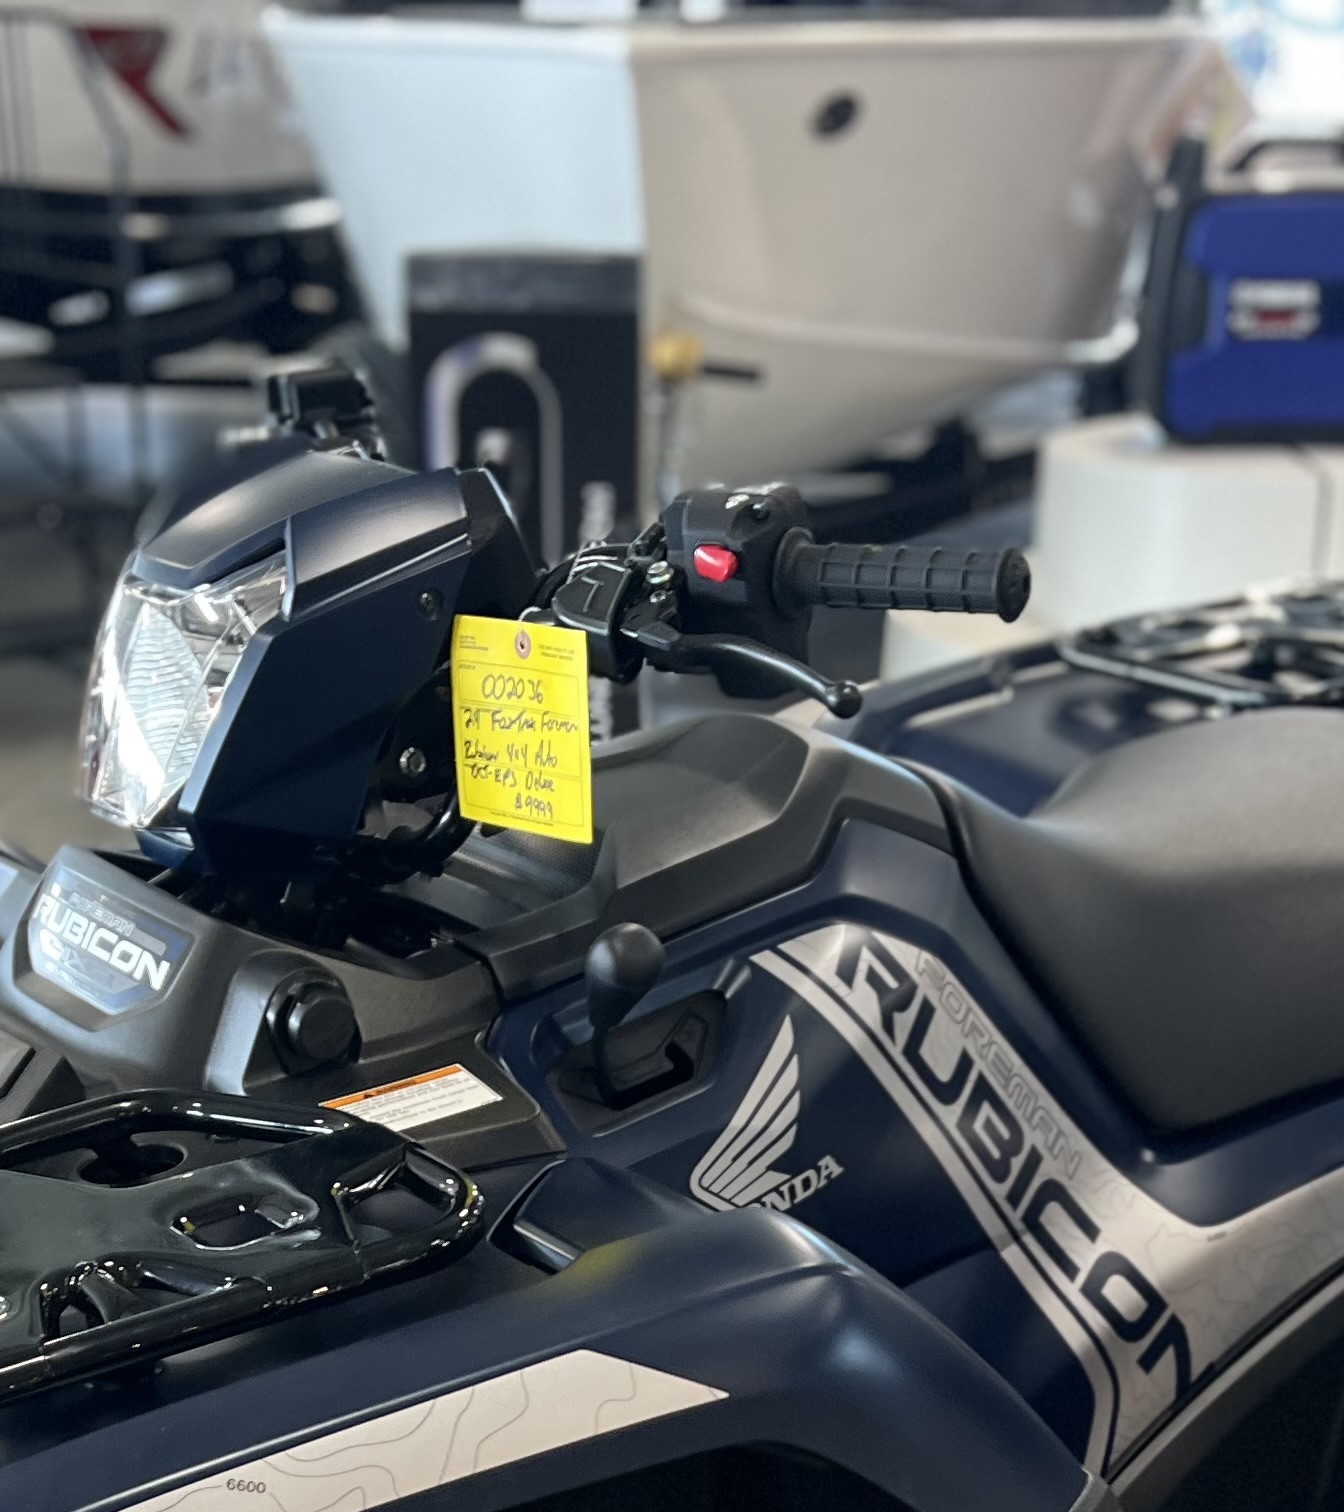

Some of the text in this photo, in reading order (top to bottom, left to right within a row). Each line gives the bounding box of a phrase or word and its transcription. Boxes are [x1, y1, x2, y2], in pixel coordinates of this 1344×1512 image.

[32, 892, 172, 991] RUBICON
[915, 949, 1083, 1181] FOREMAN
[750, 1155, 845, 1212] NDA
[835, 930, 1216, 1412] RUBICON
[226, 1478, 266, 1494] 6600
